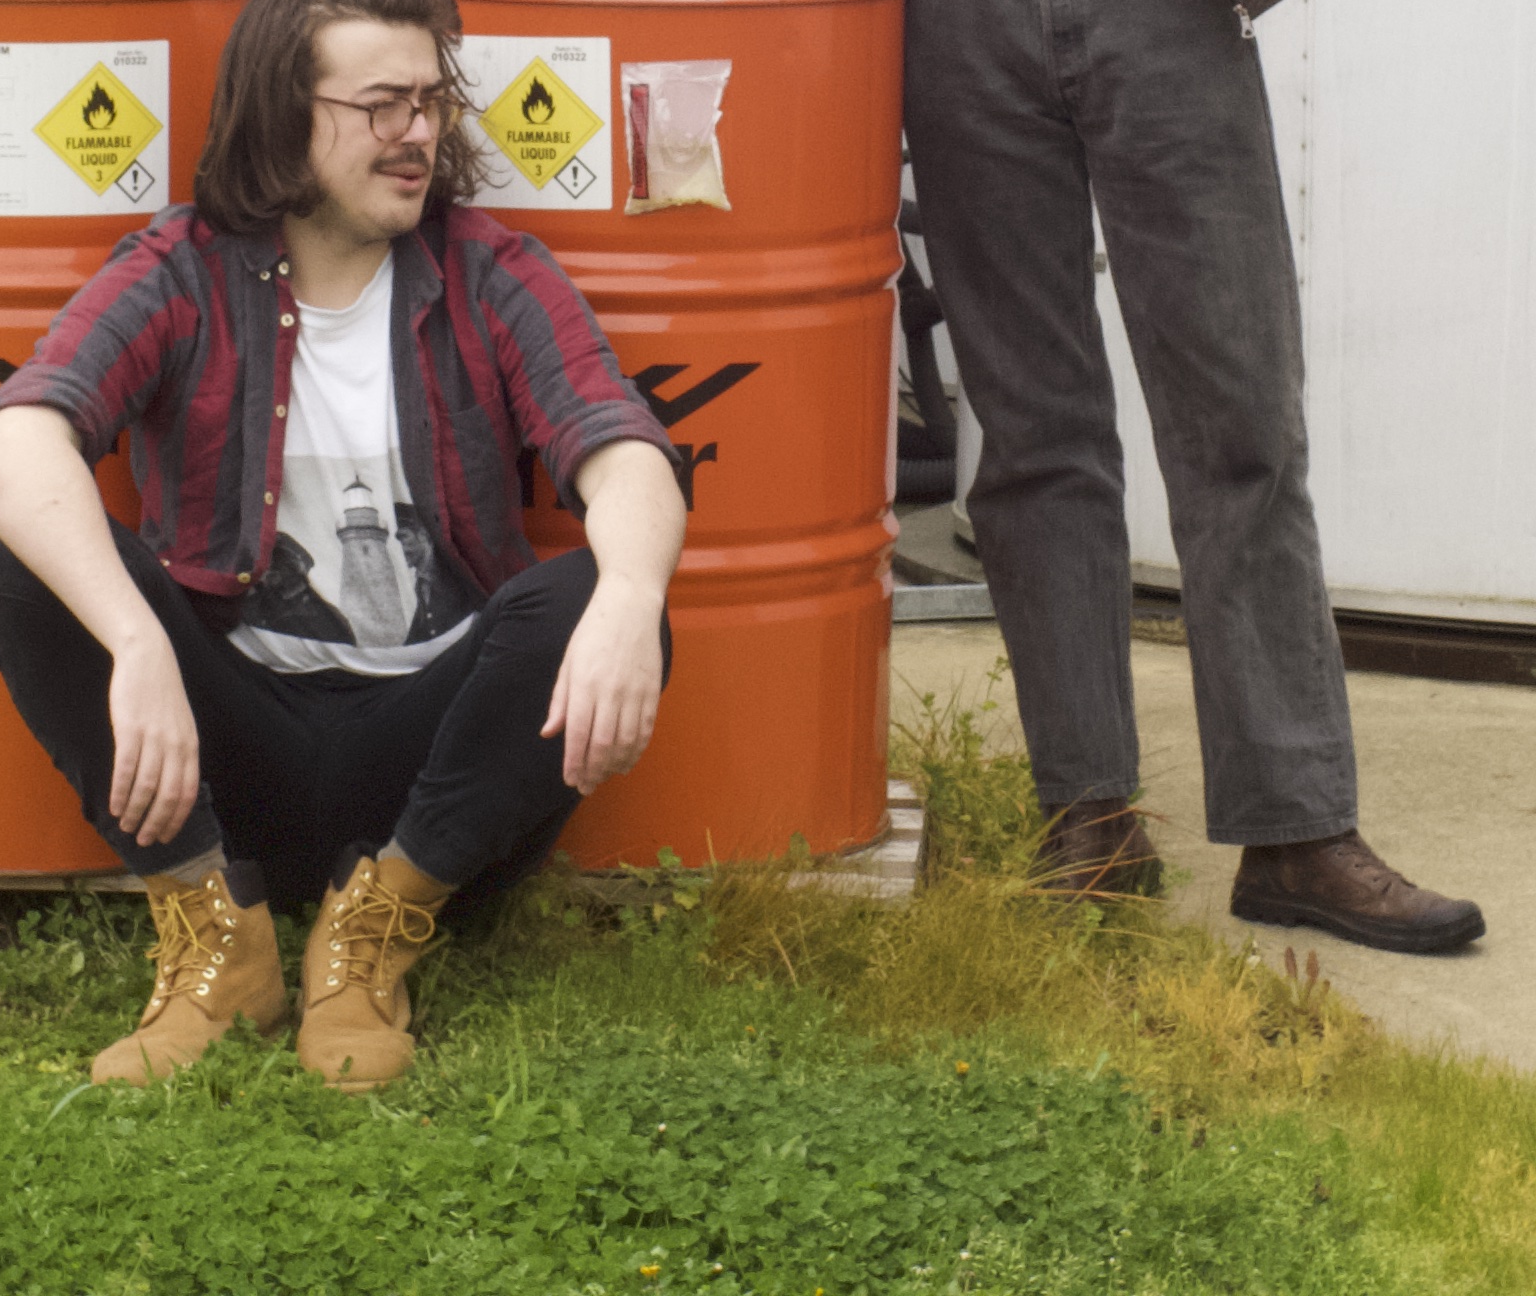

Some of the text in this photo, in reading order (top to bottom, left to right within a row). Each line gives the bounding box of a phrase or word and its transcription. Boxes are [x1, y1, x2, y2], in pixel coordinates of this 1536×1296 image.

[66, 136, 132, 150] FLAMMABLE
[506, 130, 571, 144] FLAMMABLE
[80, 154, 118, 166] LIQUID
[520, 148, 557, 160] LIQUID
[95, 170, 103, 182] 3
[535, 165, 542, 177] 3
